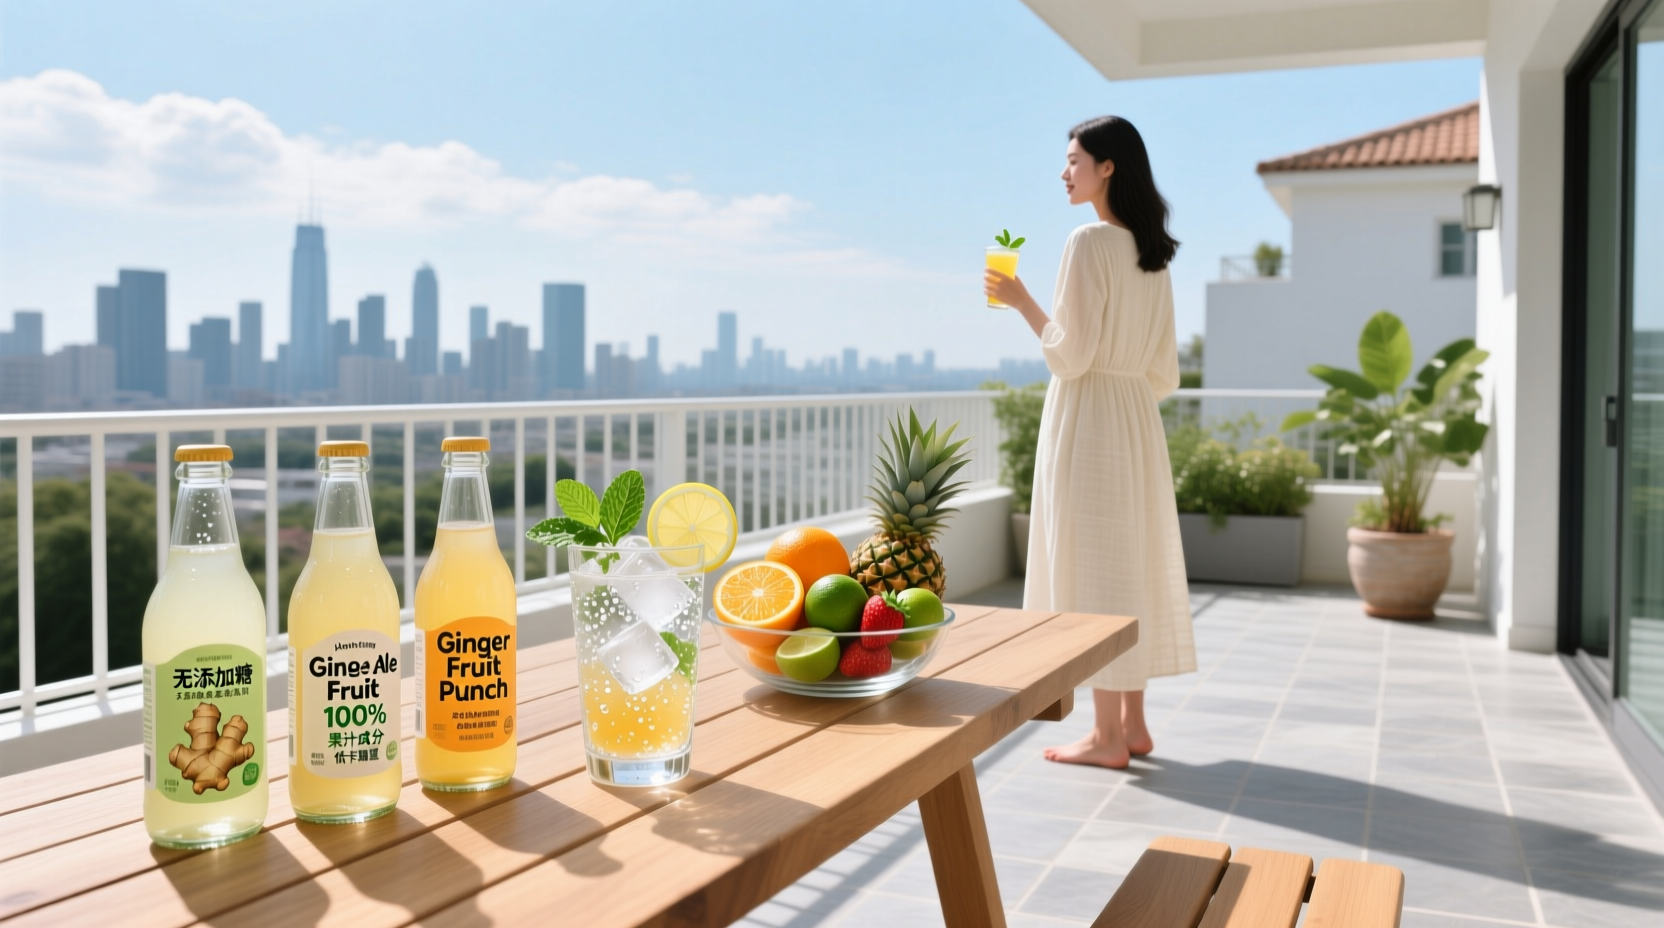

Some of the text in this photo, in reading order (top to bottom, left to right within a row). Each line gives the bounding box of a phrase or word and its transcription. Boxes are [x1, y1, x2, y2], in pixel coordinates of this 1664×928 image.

[437, 631, 510, 659] Ginger
[173, 662, 253, 689] 无添加糖
[372, 652, 398, 675] Ale
[447, 655, 501, 678] Fruit
[327, 678, 380, 701] Fruit
[440, 677, 508, 702] Punch
[323, 703, 387, 728] 100%
